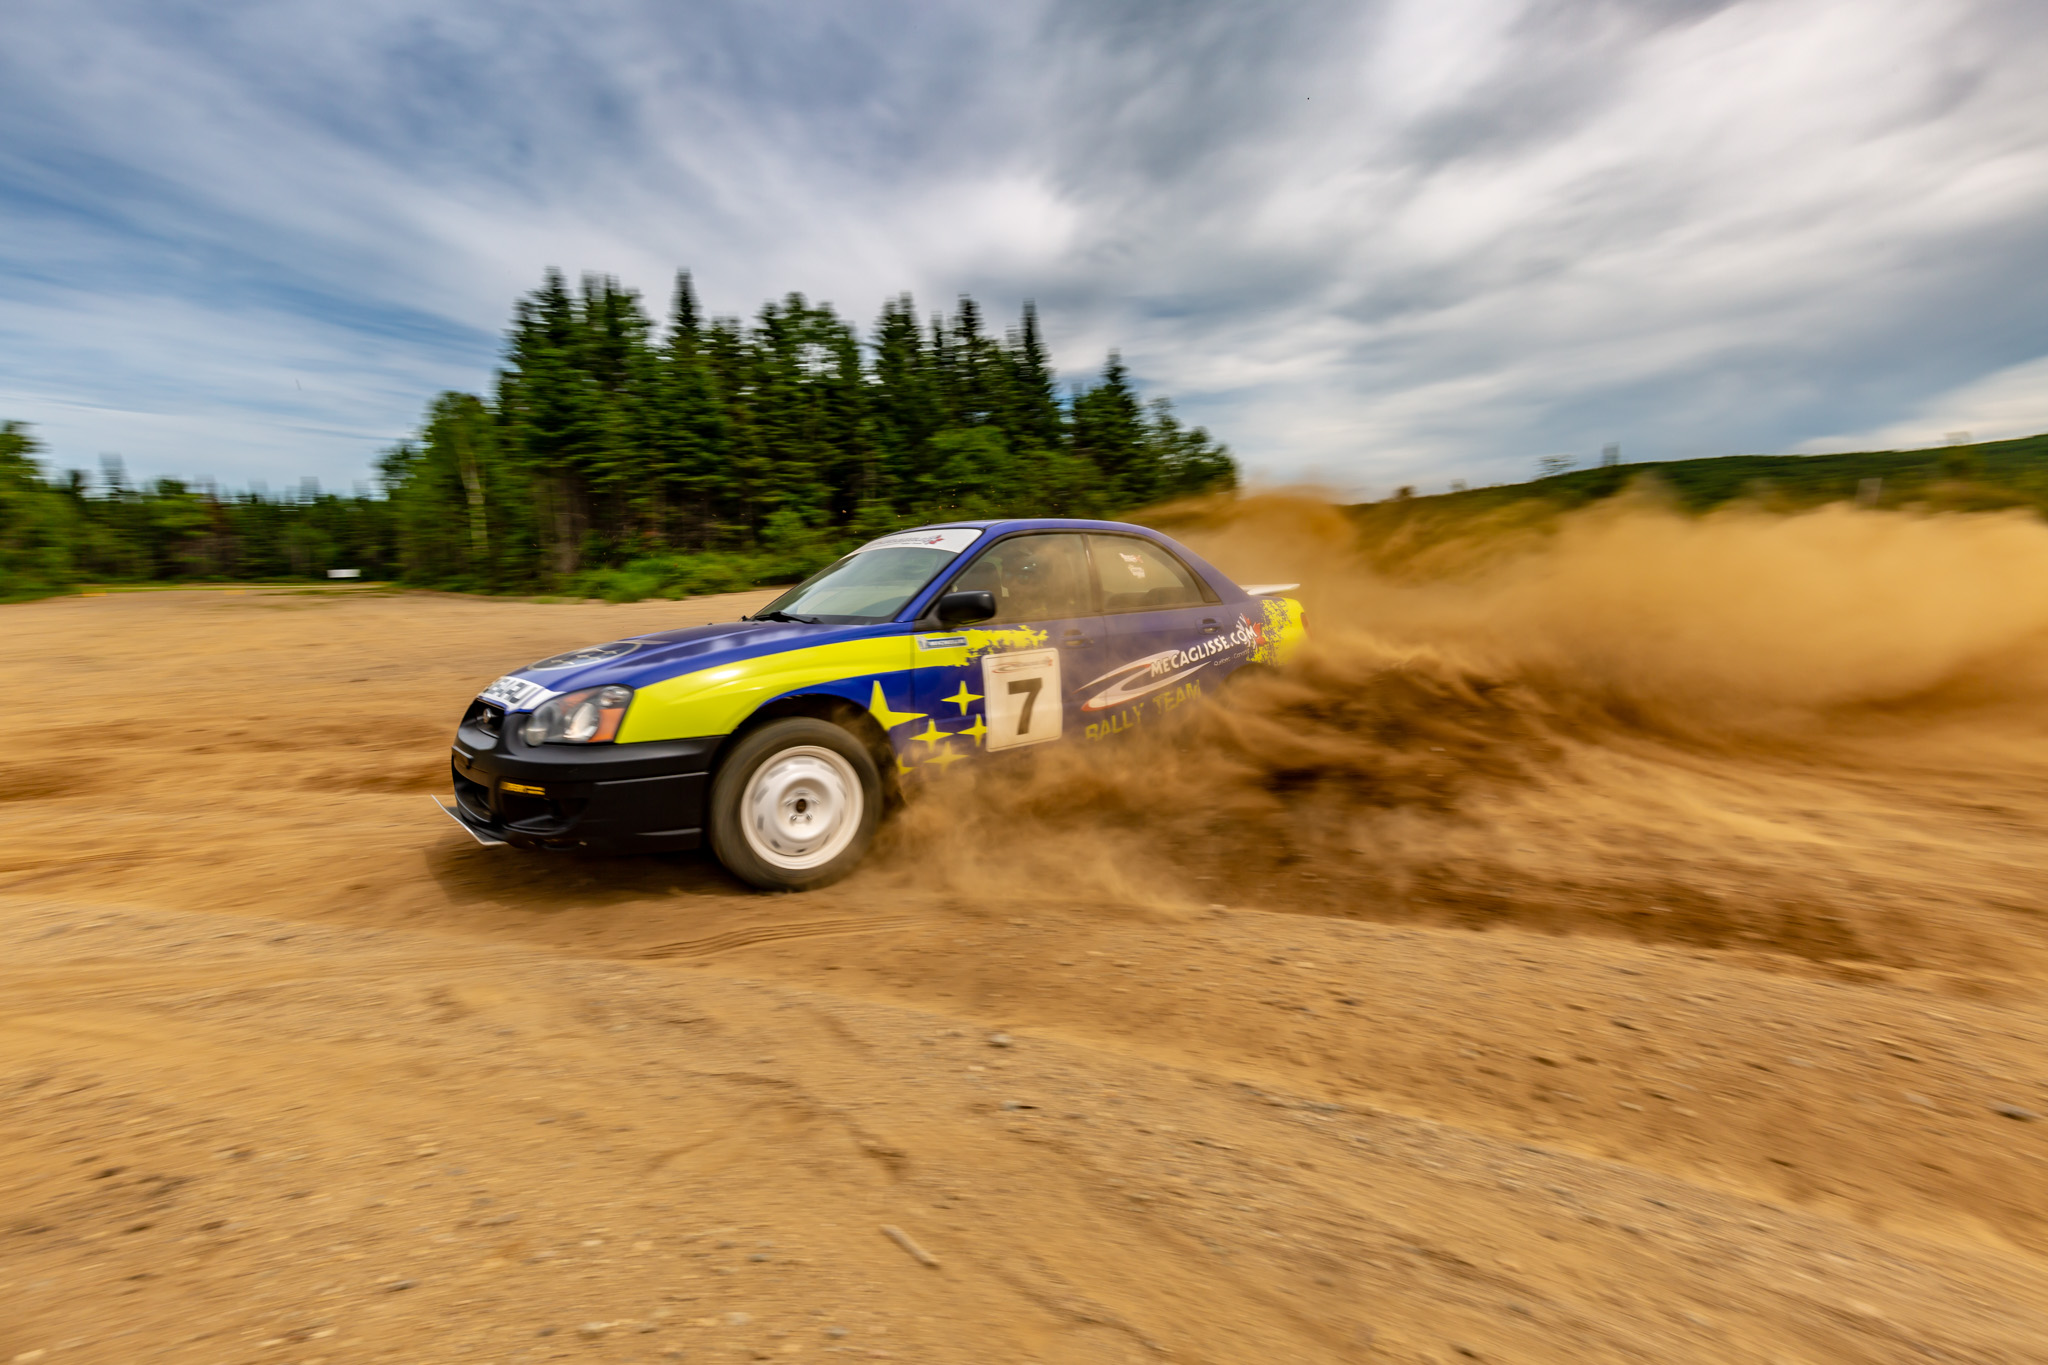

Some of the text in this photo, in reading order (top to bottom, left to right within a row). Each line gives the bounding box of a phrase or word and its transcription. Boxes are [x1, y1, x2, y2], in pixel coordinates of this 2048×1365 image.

[1150, 625, 1258, 678] MECAGLISSE.COM
[1007, 677, 1043, 736] 7
[1085, 679, 1202, 742] RALLY TEAM
